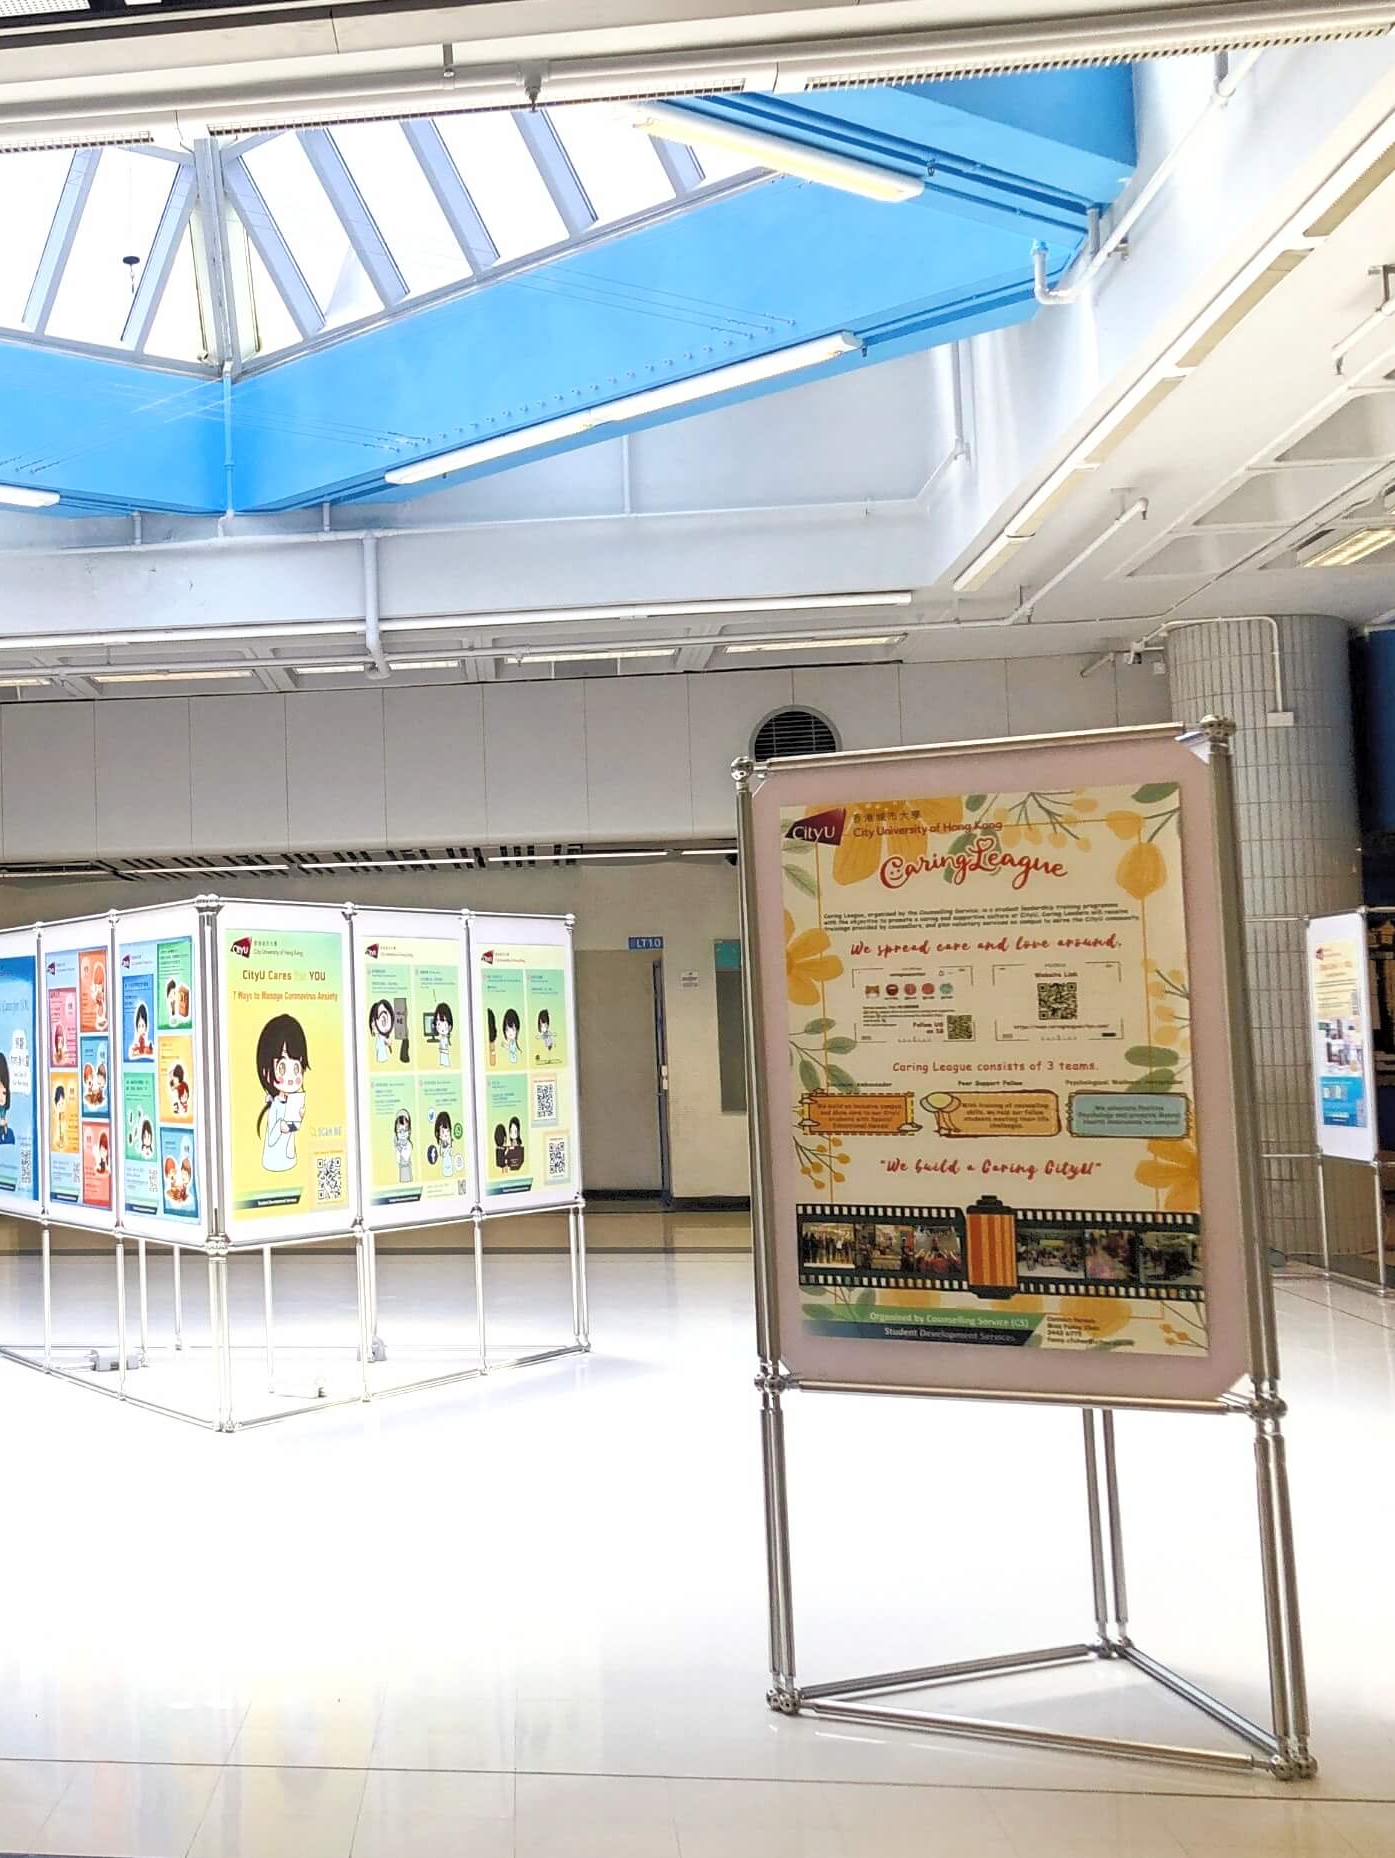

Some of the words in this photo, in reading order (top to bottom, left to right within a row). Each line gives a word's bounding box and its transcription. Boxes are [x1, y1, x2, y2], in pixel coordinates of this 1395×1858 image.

[792, 825, 836, 842] CityU
[854, 827, 876, 839] City
[877, 824, 929, 839] University
[929, 823, 941, 834] of
[943, 822, 973, 835] Hong
[974, 821, 1003, 834] Kong
[880, 853, 970, 890] Caring
[968, 836, 1068, 891] League
[636, 938, 662, 948] LT10
[850, 941, 872, 956] We
[876, 939, 931, 958] spread
[936, 942, 972, 953] care
[977, 937, 1010, 952] and
[1015, 935, 1050, 951] love
[1057, 932, 1122, 949] around.
[243, 970, 265, 982] CityU
[268, 970, 292, 981] Cares
[309, 971, 326, 981] YOU
[892, 1061, 929, 1074] Caring
[933, 1061, 973, 1073] League
[977, 1061, 1026, 1072] consists
[1029, 1060, 1042, 1071] of
[1047, 1060, 1055, 1071] 3
[1059, 1061, 1099, 1072] teams.
[915, 1158, 960, 1174] build
[981, 1158, 1037, 1180] Caring
[869, 1312, 913, 1323] Organised
[914, 1313, 925, 1324] by
[926, 1314, 976, 1327] Counselling
[883, 1327, 918, 1337] Student
